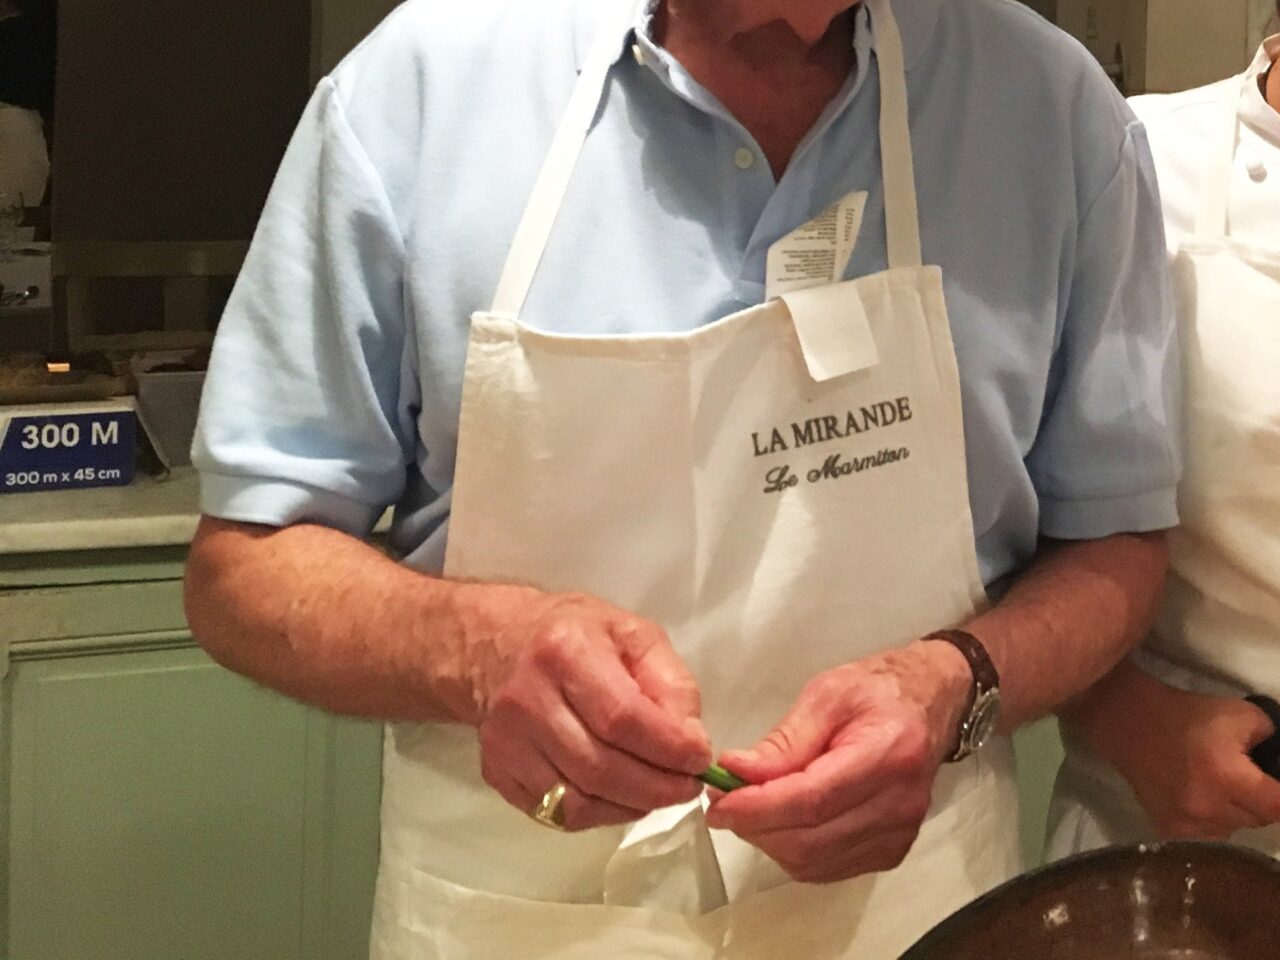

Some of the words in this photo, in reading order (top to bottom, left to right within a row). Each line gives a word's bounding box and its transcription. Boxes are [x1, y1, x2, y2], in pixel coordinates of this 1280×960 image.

[21, 422, 80, 450] 300
[91, 420, 119, 446] M
[751, 427, 789, 457] LA
[790, 396, 913, 448] MIRANDE
[5, 471, 40, 486] 300
[42, 473, 58, 483] m
[61, 471, 71, 482] x
[74, 467, 95, 481] 45
[97, 468, 120, 480] cm
[763, 464, 799, 494] Le
[806, 446, 910, 483] Marmiton
